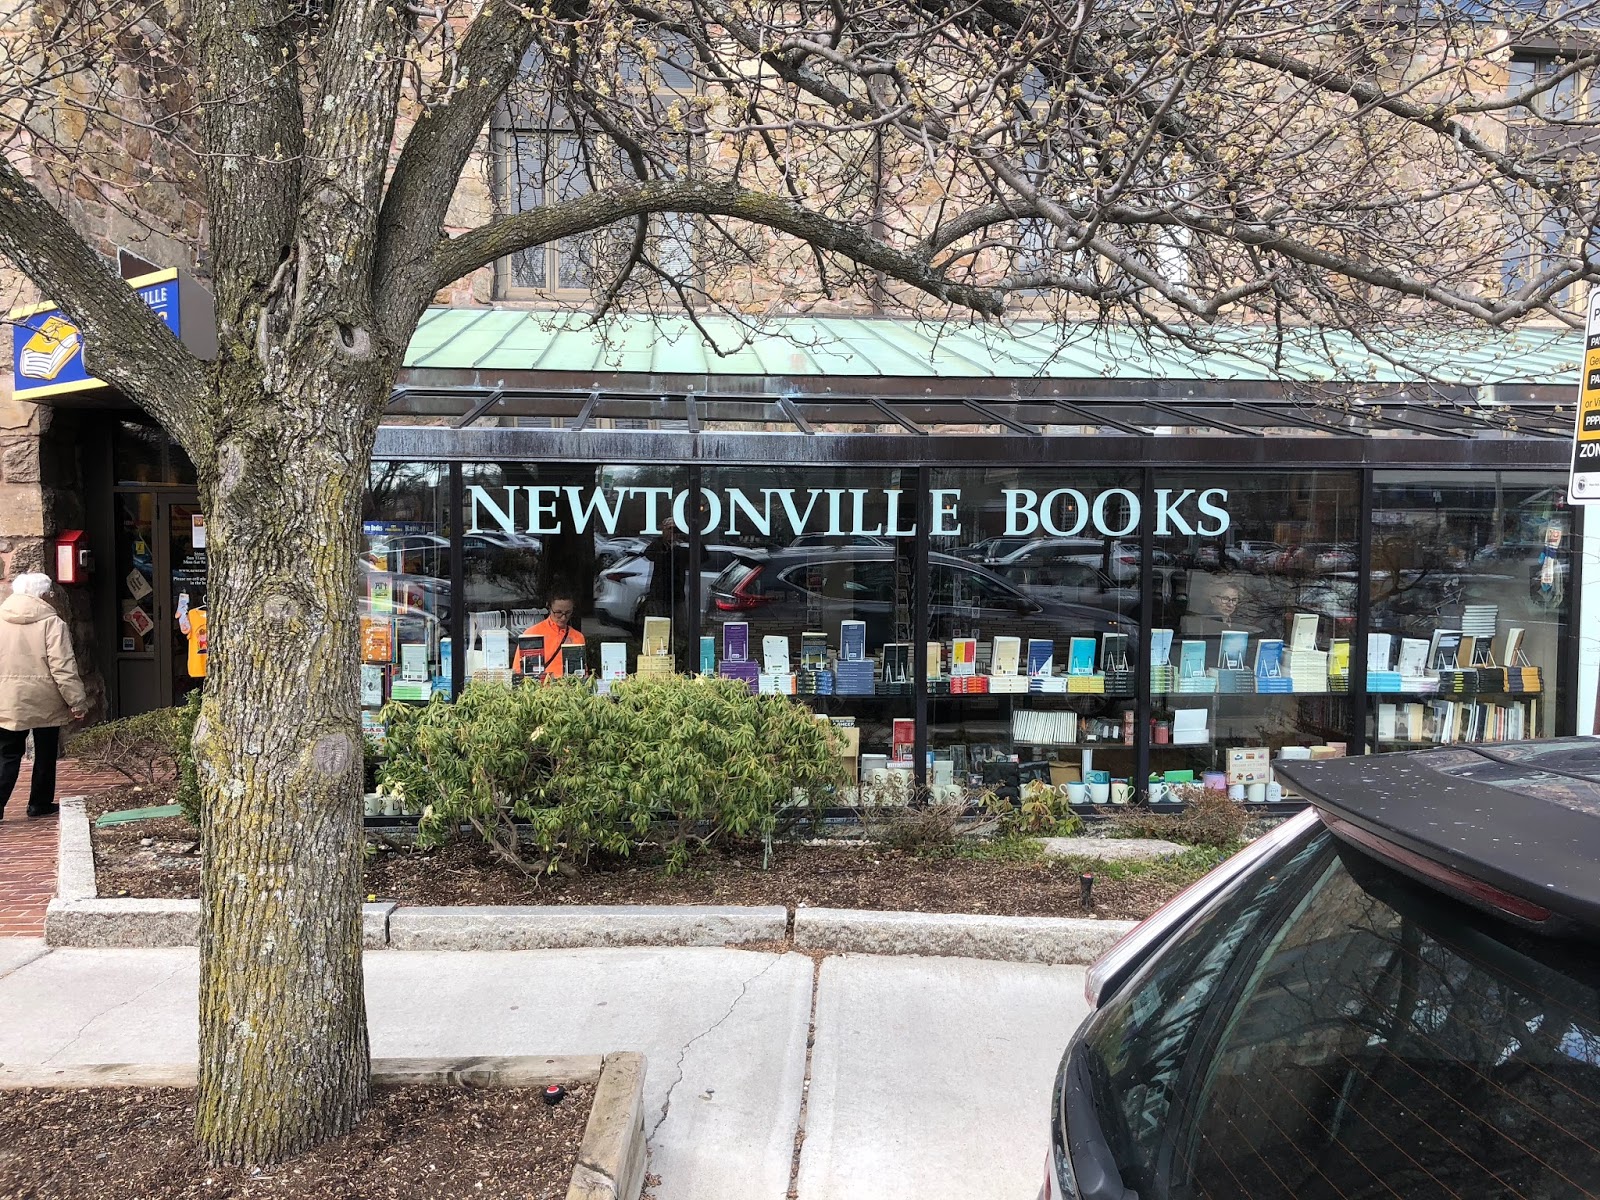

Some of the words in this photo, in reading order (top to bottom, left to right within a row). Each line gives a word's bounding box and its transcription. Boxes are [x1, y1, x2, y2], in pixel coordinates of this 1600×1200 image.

[140, 287, 167, 305] ILLE
[1589, 355, 1600, 366] Ge
[1590, 374, 1600, 385] PA
[1585, 400, 1593, 409] or
[465, 485, 962, 537] NEWTONVILLE
[1001, 488, 1231, 537] BOOKS
[1117, 788, 1125, 800] Y
